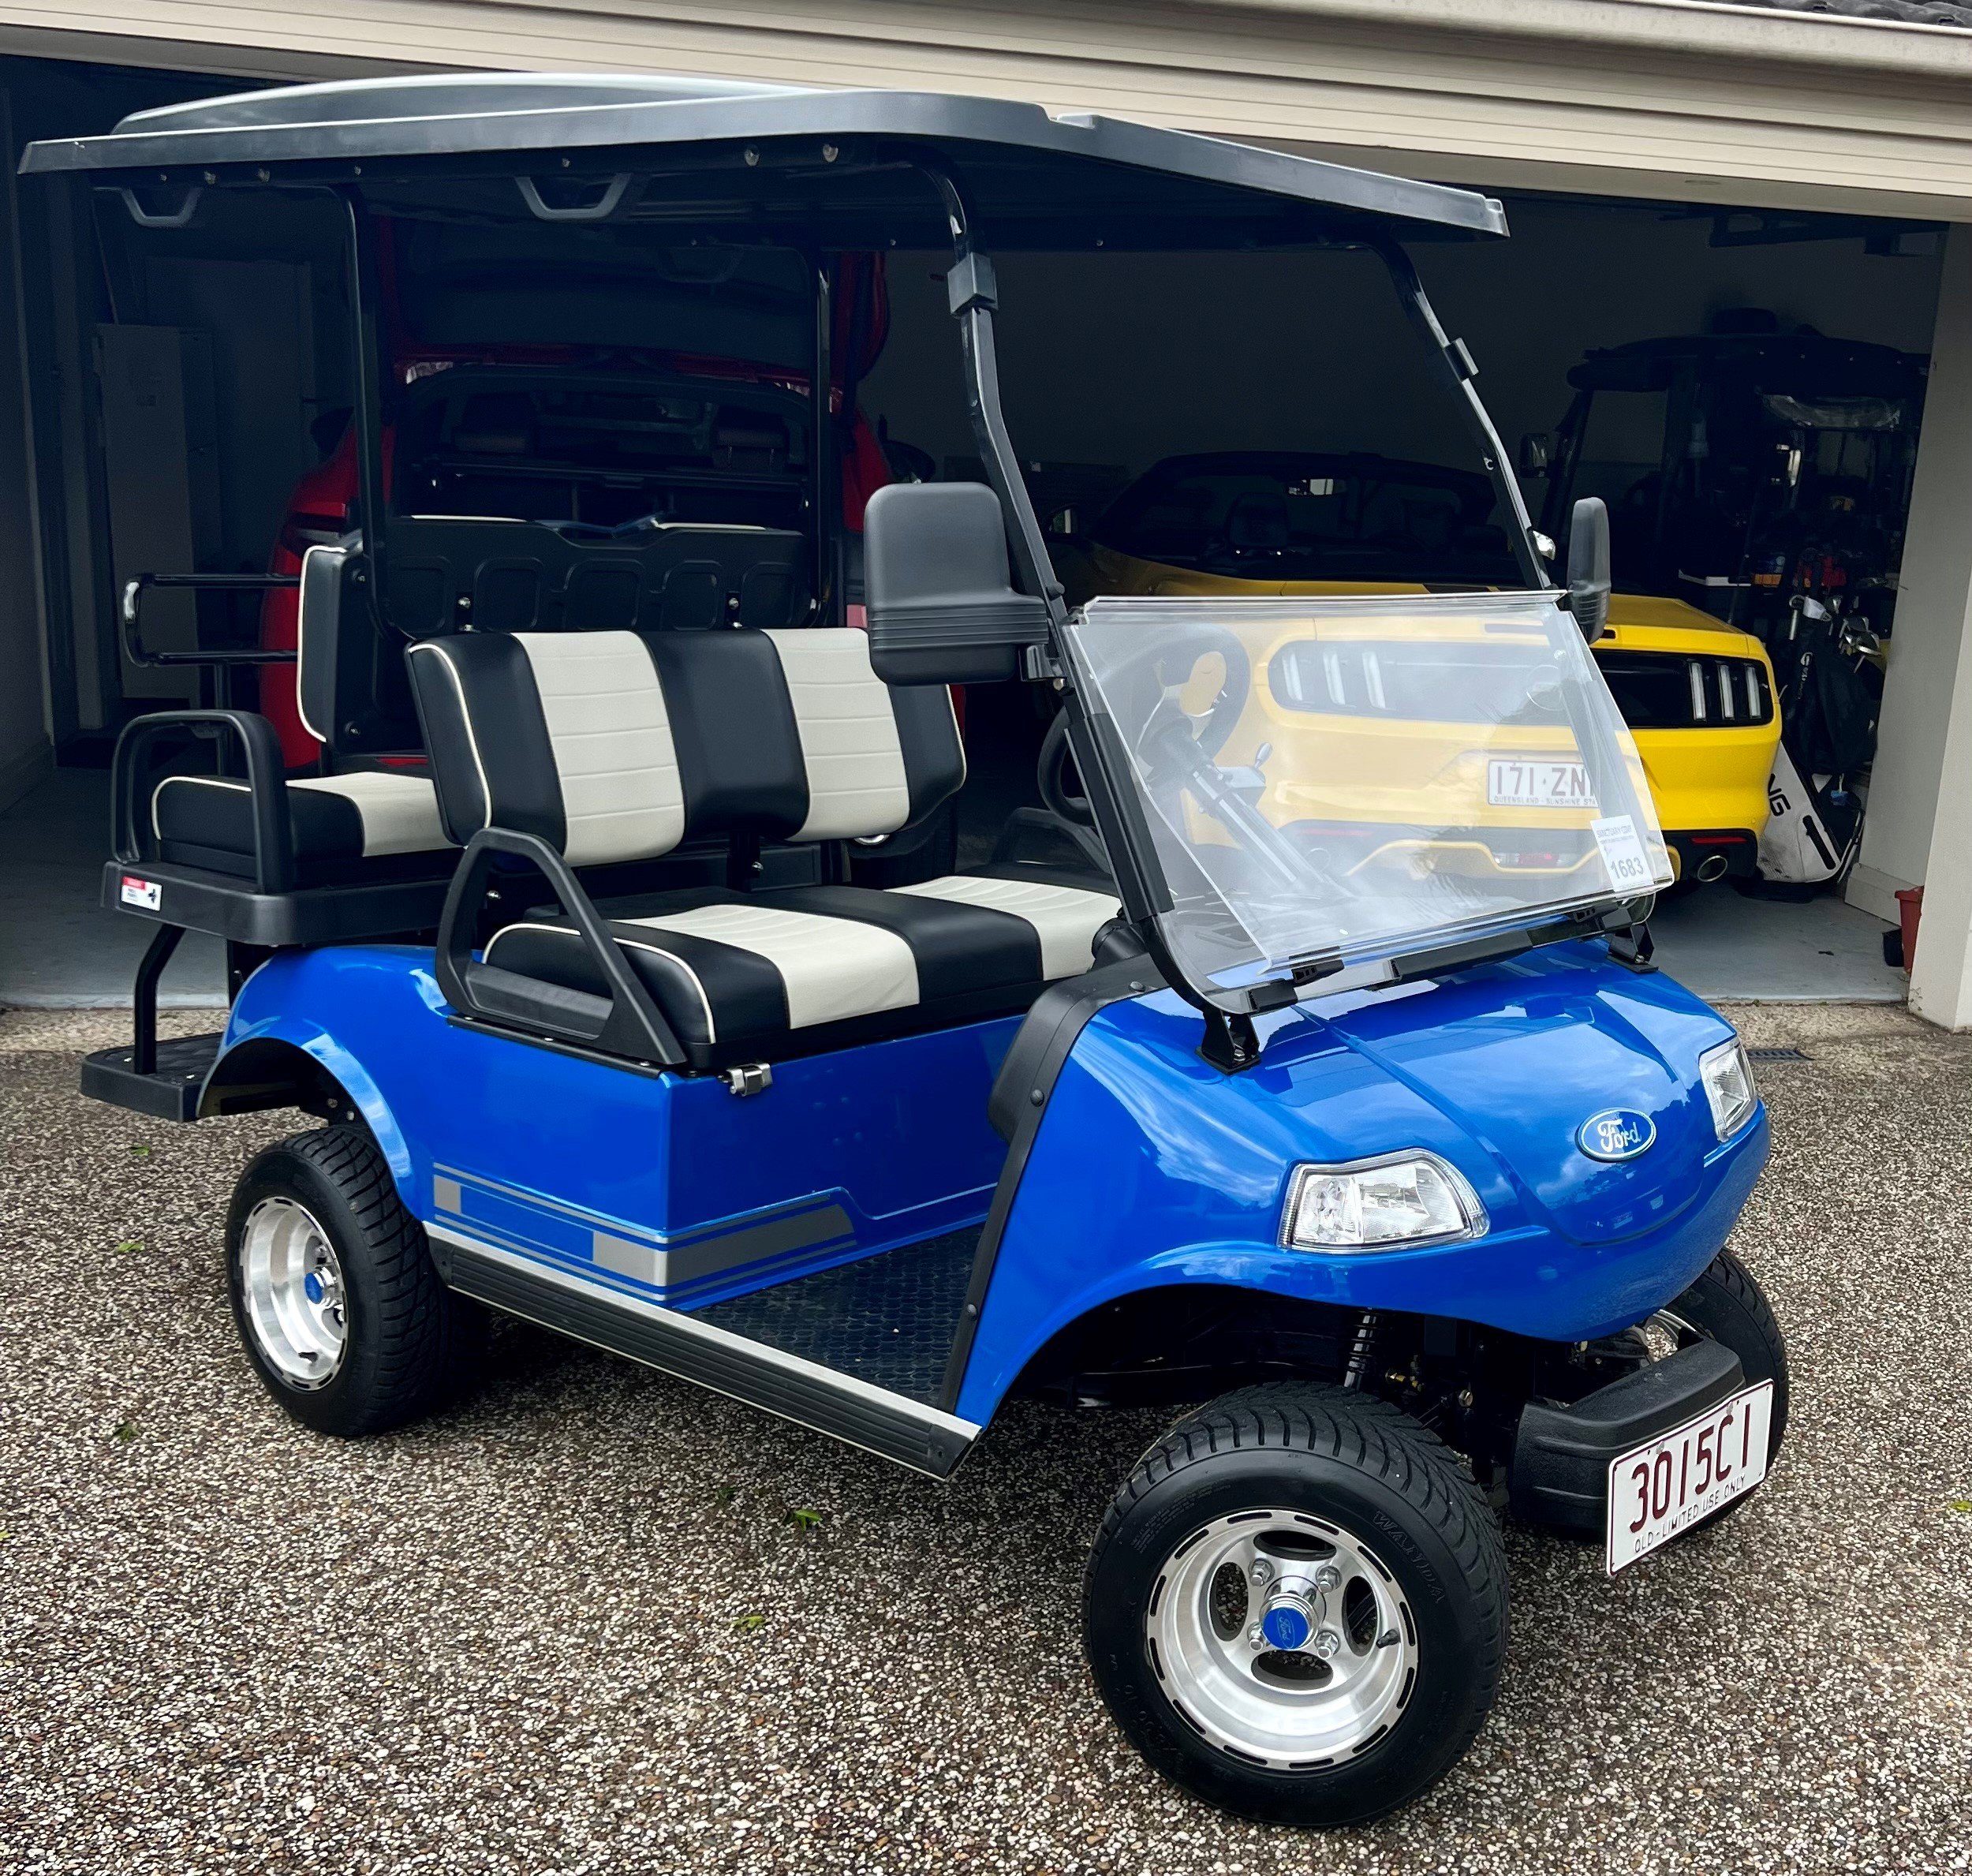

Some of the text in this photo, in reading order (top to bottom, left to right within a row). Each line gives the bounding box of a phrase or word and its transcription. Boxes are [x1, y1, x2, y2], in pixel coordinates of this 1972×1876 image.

[1610, 857, 1644, 879] 1683
[1597, 1118, 1641, 1153] Ford
[1702, 1489, 1720, 1512] USE
[1724, 1473, 1746, 1497] ONLY
